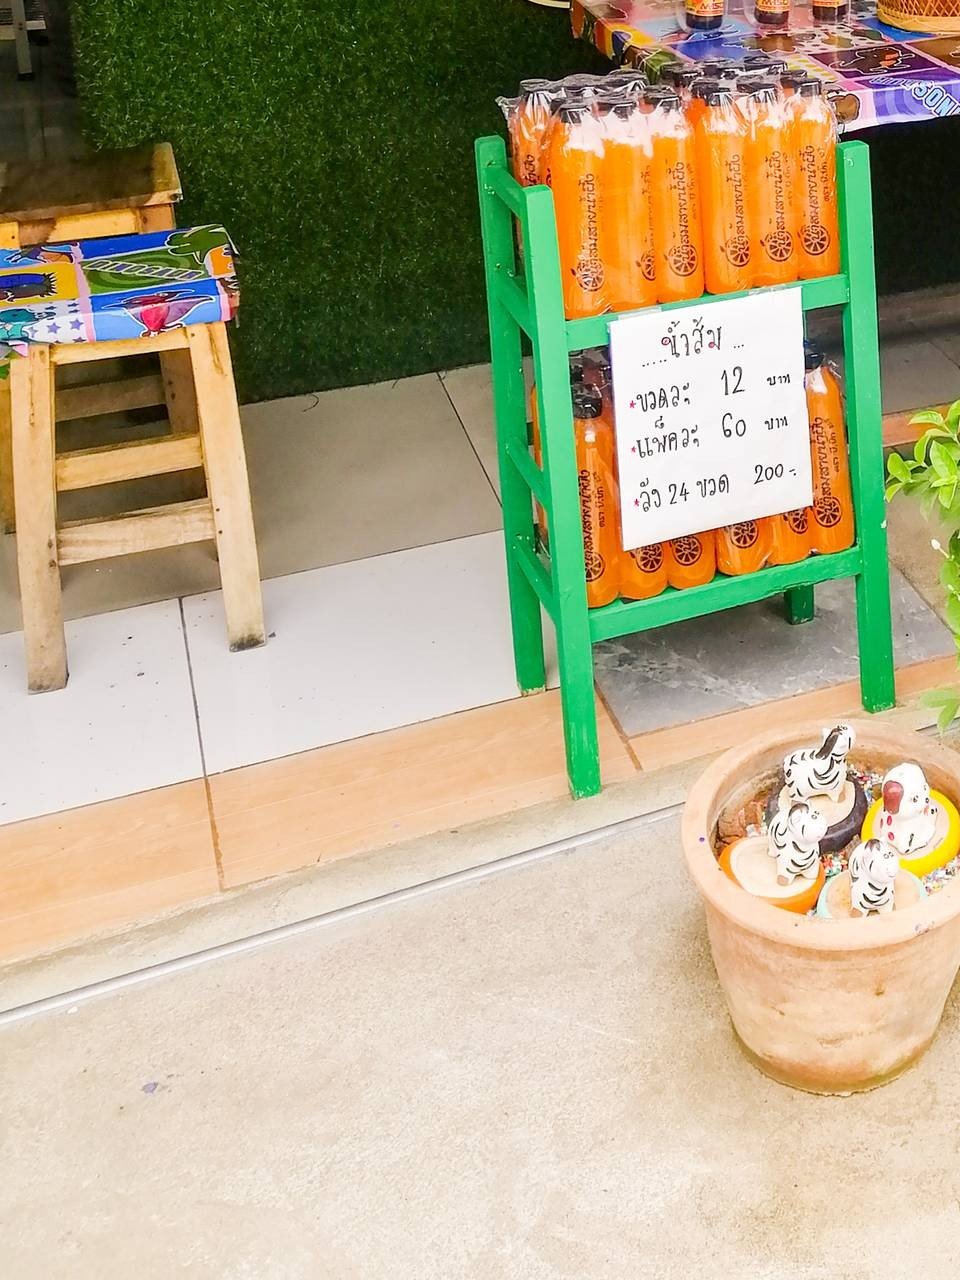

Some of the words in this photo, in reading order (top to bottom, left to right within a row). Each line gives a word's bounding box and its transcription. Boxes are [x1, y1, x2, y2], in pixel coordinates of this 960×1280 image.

[661, 317, 721, 358] น้ำส้ม
[637, 383, 690, 412] ขวดละ
[721, 366, 745, 396] 12
[767, 373, 790, 386] บาท
[637, 416, 699, 458] แพ็คละ
[722, 413, 746, 438] 60
[765, 416, 788, 430] บาท
[640, 477, 661, 512] ลัง
[668, 482, 689, 505] 24
[697, 474, 729, 497] ขวด
